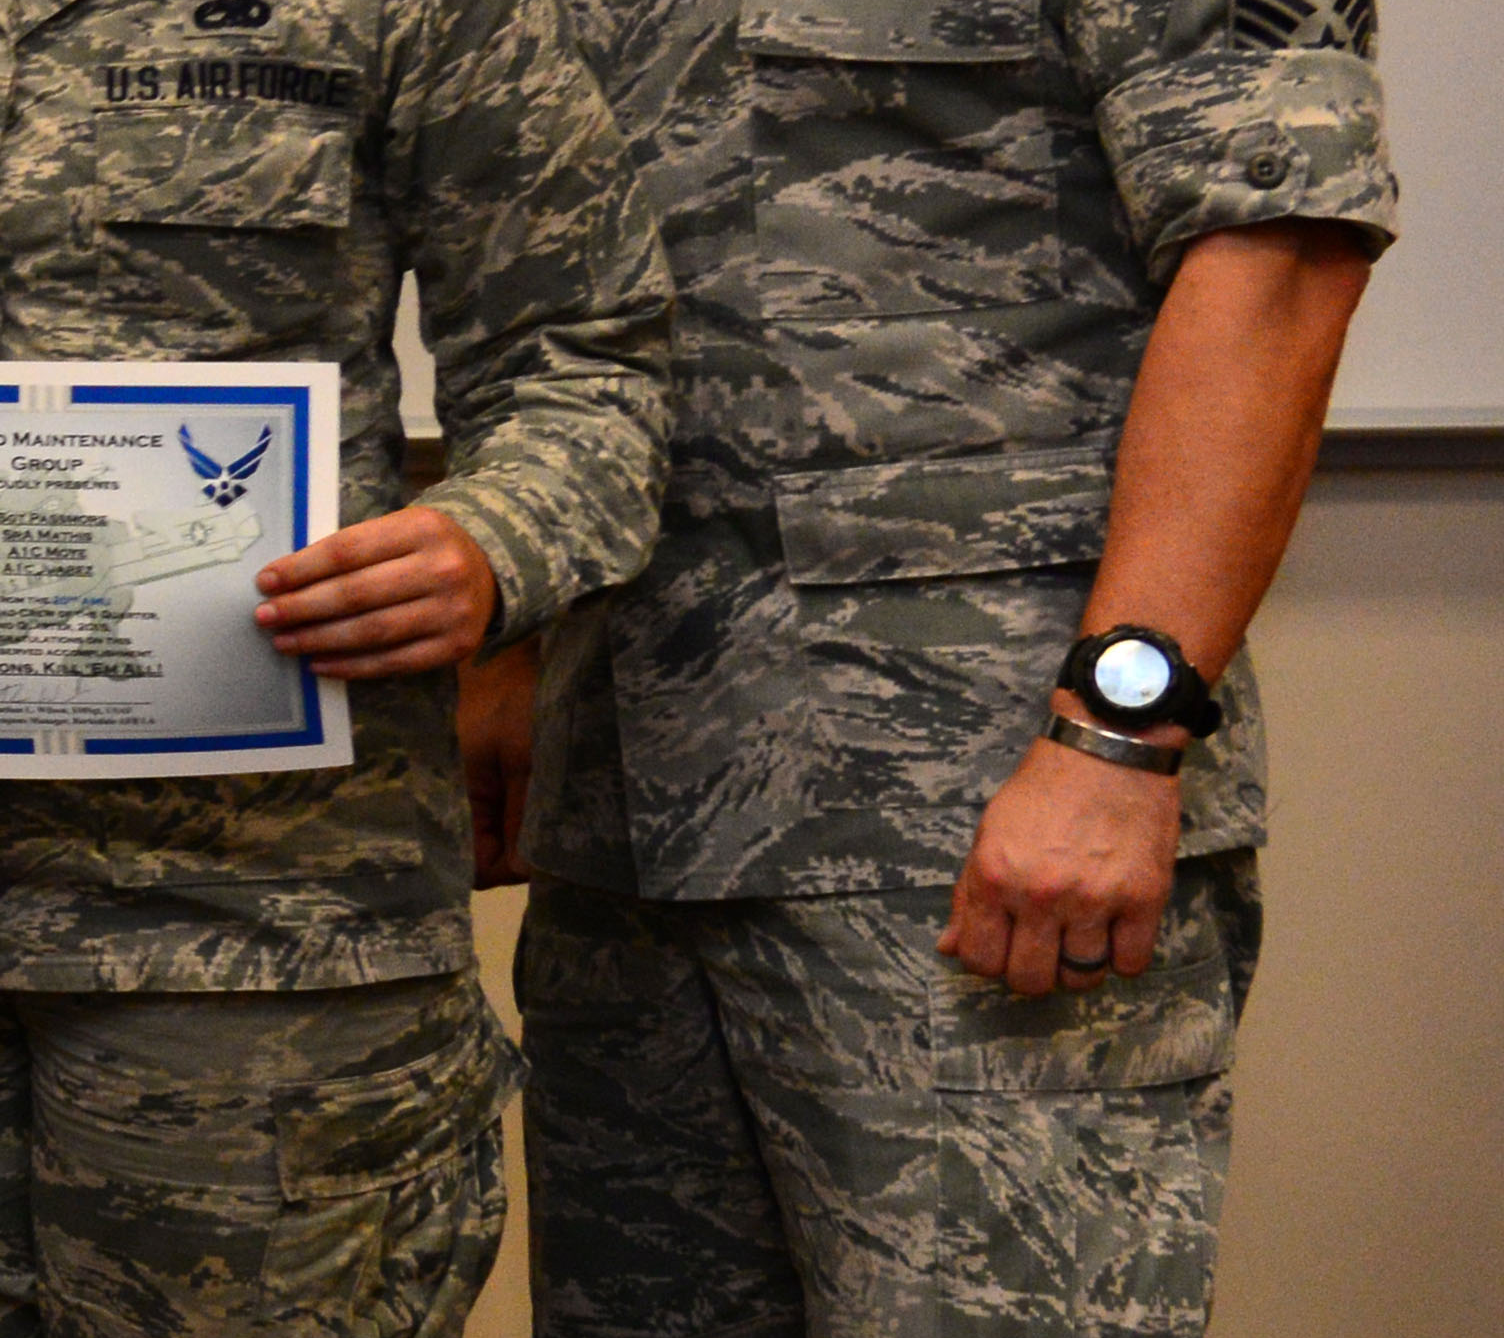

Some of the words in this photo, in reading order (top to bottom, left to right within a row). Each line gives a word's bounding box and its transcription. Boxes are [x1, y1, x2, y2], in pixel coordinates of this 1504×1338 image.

[106, 64, 167, 102] U.S.
[177, 61, 232, 100] AIR
[239, 62, 352, 107] FORCE
[13, 432, 163, 447] MAINTENANCE
[12, 456, 83, 471] GROUP
